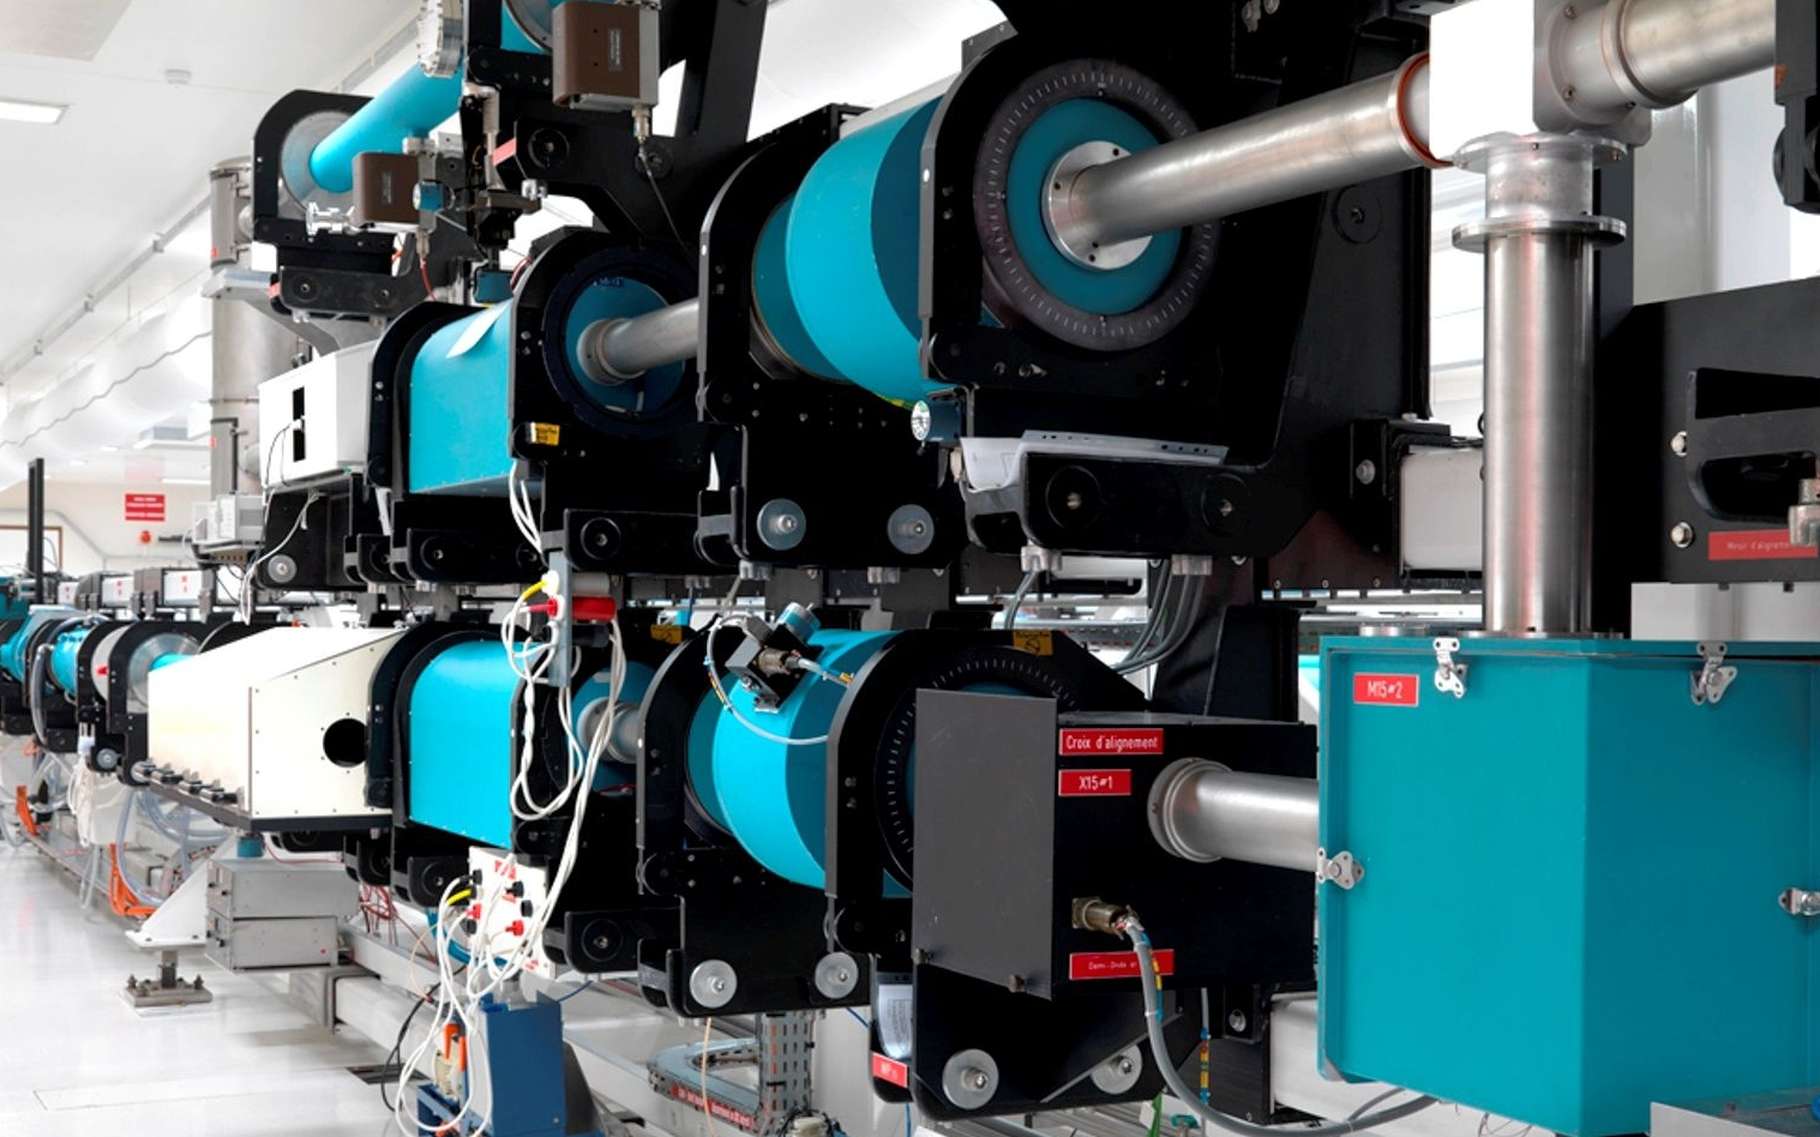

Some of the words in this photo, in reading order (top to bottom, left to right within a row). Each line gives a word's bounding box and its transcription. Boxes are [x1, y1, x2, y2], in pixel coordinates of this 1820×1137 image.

[1065, 734, 1091, 750] Croix
[1095, 735, 1158, 753] d'alignement
[1078, 775, 1113, 790] X15#1
